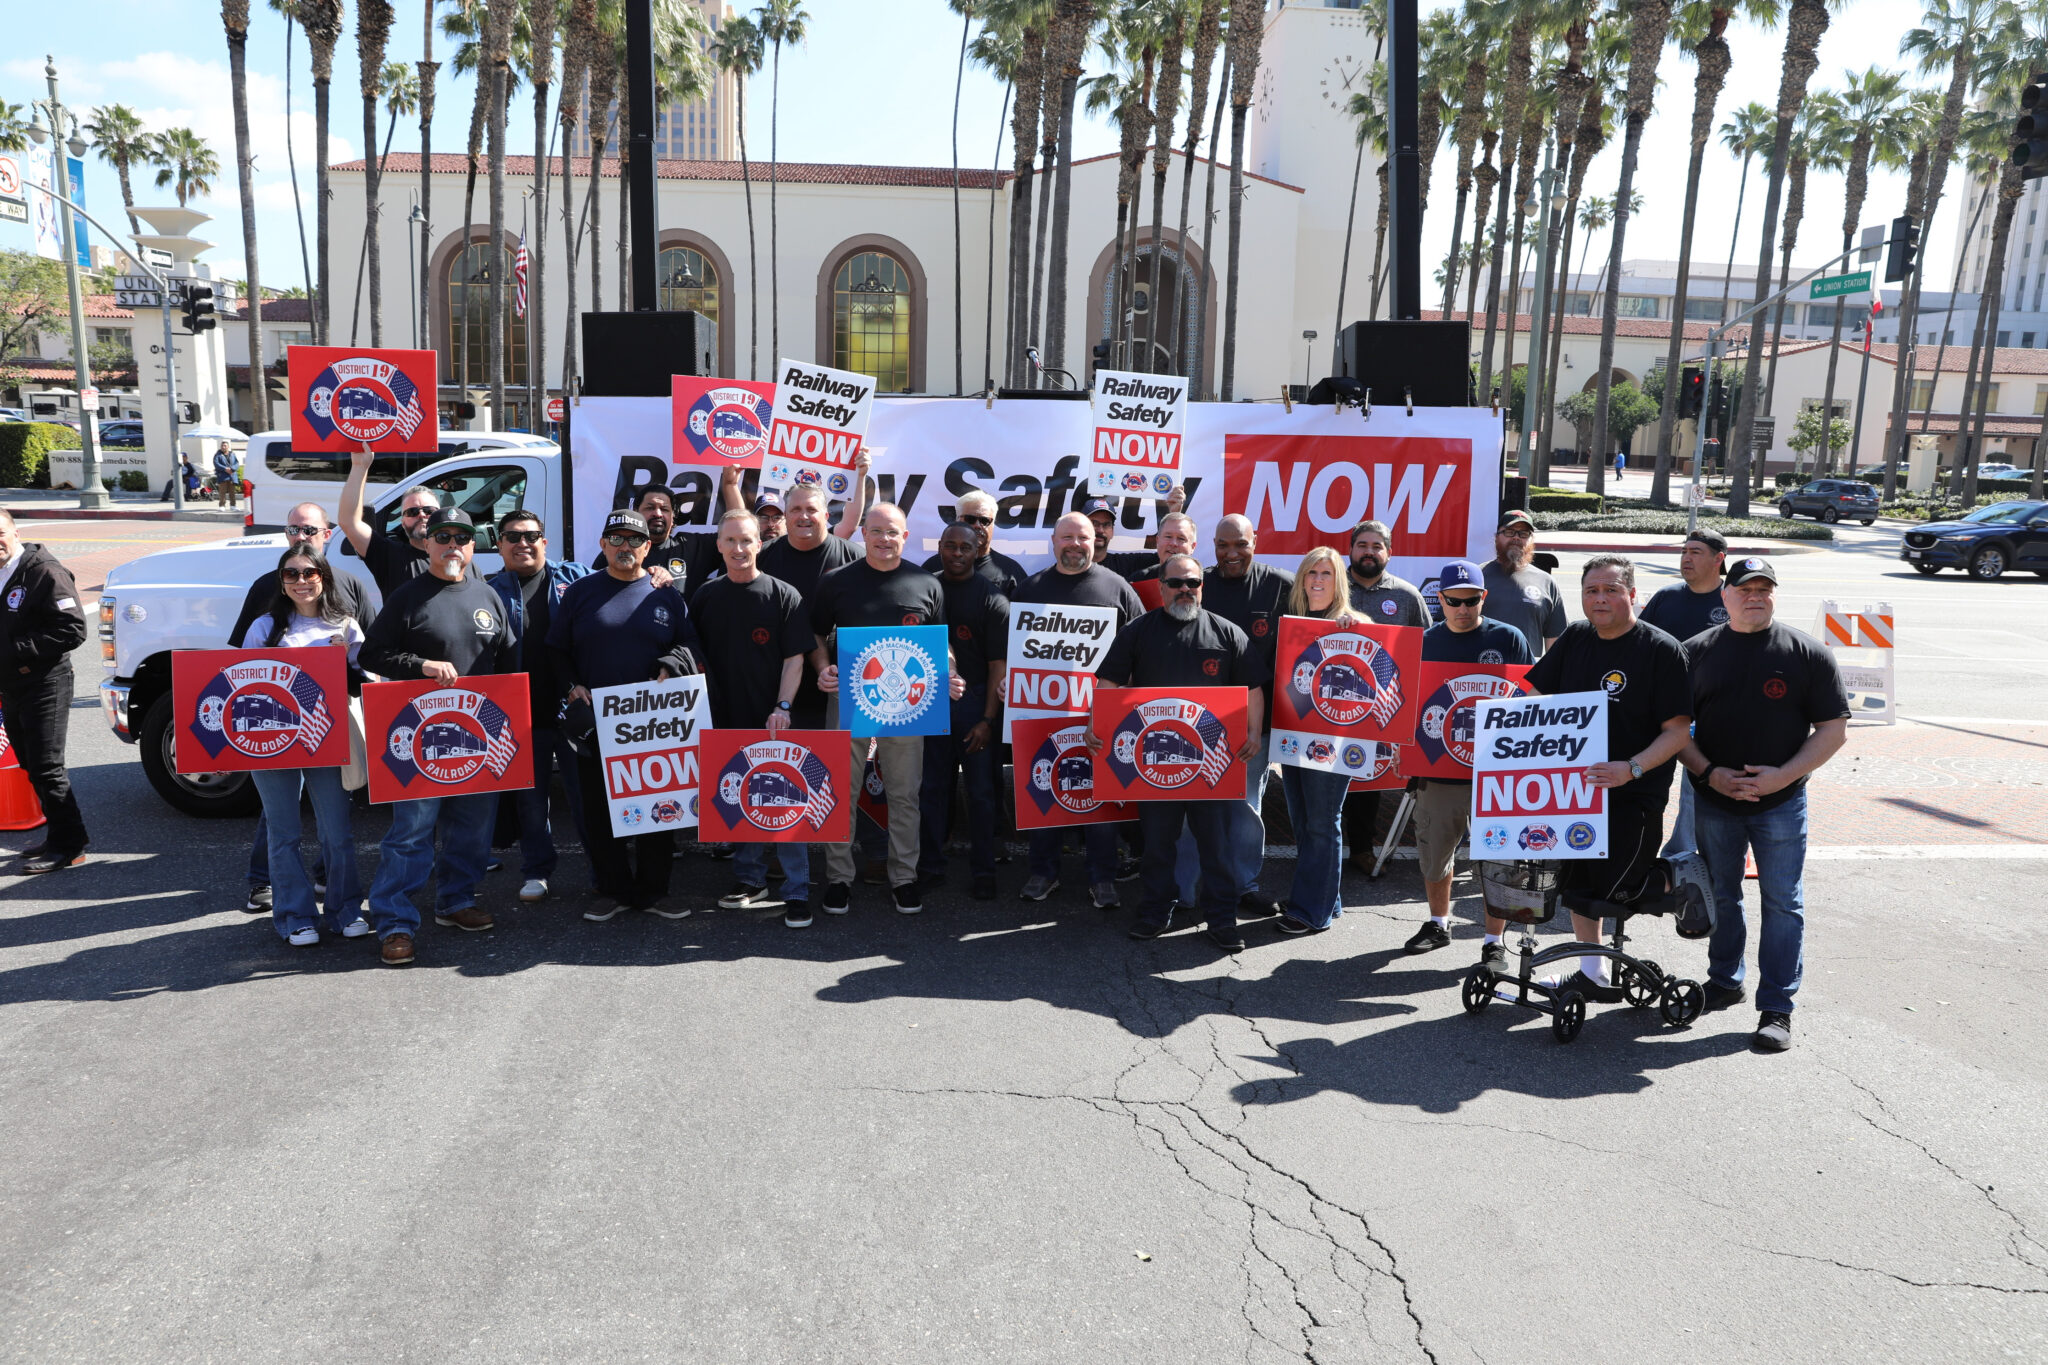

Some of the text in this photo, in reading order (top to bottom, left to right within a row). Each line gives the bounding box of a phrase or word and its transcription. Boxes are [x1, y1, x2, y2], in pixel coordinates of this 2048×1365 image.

[8, 202, 24, 217] WAY
[1824, 278, 1868, 291] UNION STATION
[120, 292, 180, 305] STATO
[338, 364, 390, 378] DISTRICT 19
[784, 367, 868, 404] Railway
[1102, 377, 1182, 405] Railway
[713, 392, 756, 405] DISTRICT 19
[787, 394, 856, 427] Safety
[1106, 402, 1174, 428] Safety
[342, 422, 388, 438] RAILROAD
[715, 440, 754, 454] RAILROAD
[773, 424, 858, 466] NOW
[1097, 432, 1179, 466] NOW
[1244, 460, 1458, 534] NOW
[608, 514, 644, 527] Raiders
[1457, 566, 1468, 579] LA
[1016, 610, 1109, 640] Railway
[1022, 638, 1100, 667] Safety
[1324, 639, 1374, 655] DISTRICT 19
[232, 666, 291, 682] DISTRICT 19
[856, 650, 876, 683] ASSOCIATION
[886, 643, 919, 656] MACHINISTS
[922, 669, 932, 702] AEROSPACE
[868, 687, 920, 698] A M
[1012, 672, 1098, 708] NOW
[1454, 681, 1510, 695] DISTRICT 19
[420, 694, 477, 710] DISTRICT 19
[602, 688, 700, 717] Railway
[1144, 704, 1197, 719] DISTRICT 19
[1320, 701, 1364, 720] RAILROAD
[1484, 704, 1598, 730] Railway
[614, 717, 695, 745] Safety
[235, 733, 290, 752] RAILROAD
[1492, 734, 1588, 761] Safety
[749, 746, 802, 762] DISTRICT 19
[426, 759, 477, 779] RAILROAD
[610, 751, 699, 794] NOW
[1144, 768, 1193, 784] RAILROAD
[1061, 793, 1096, 808] RAILRO
[1481, 772, 1599, 812] NOW
[750, 809, 798, 826] RAILROAD
